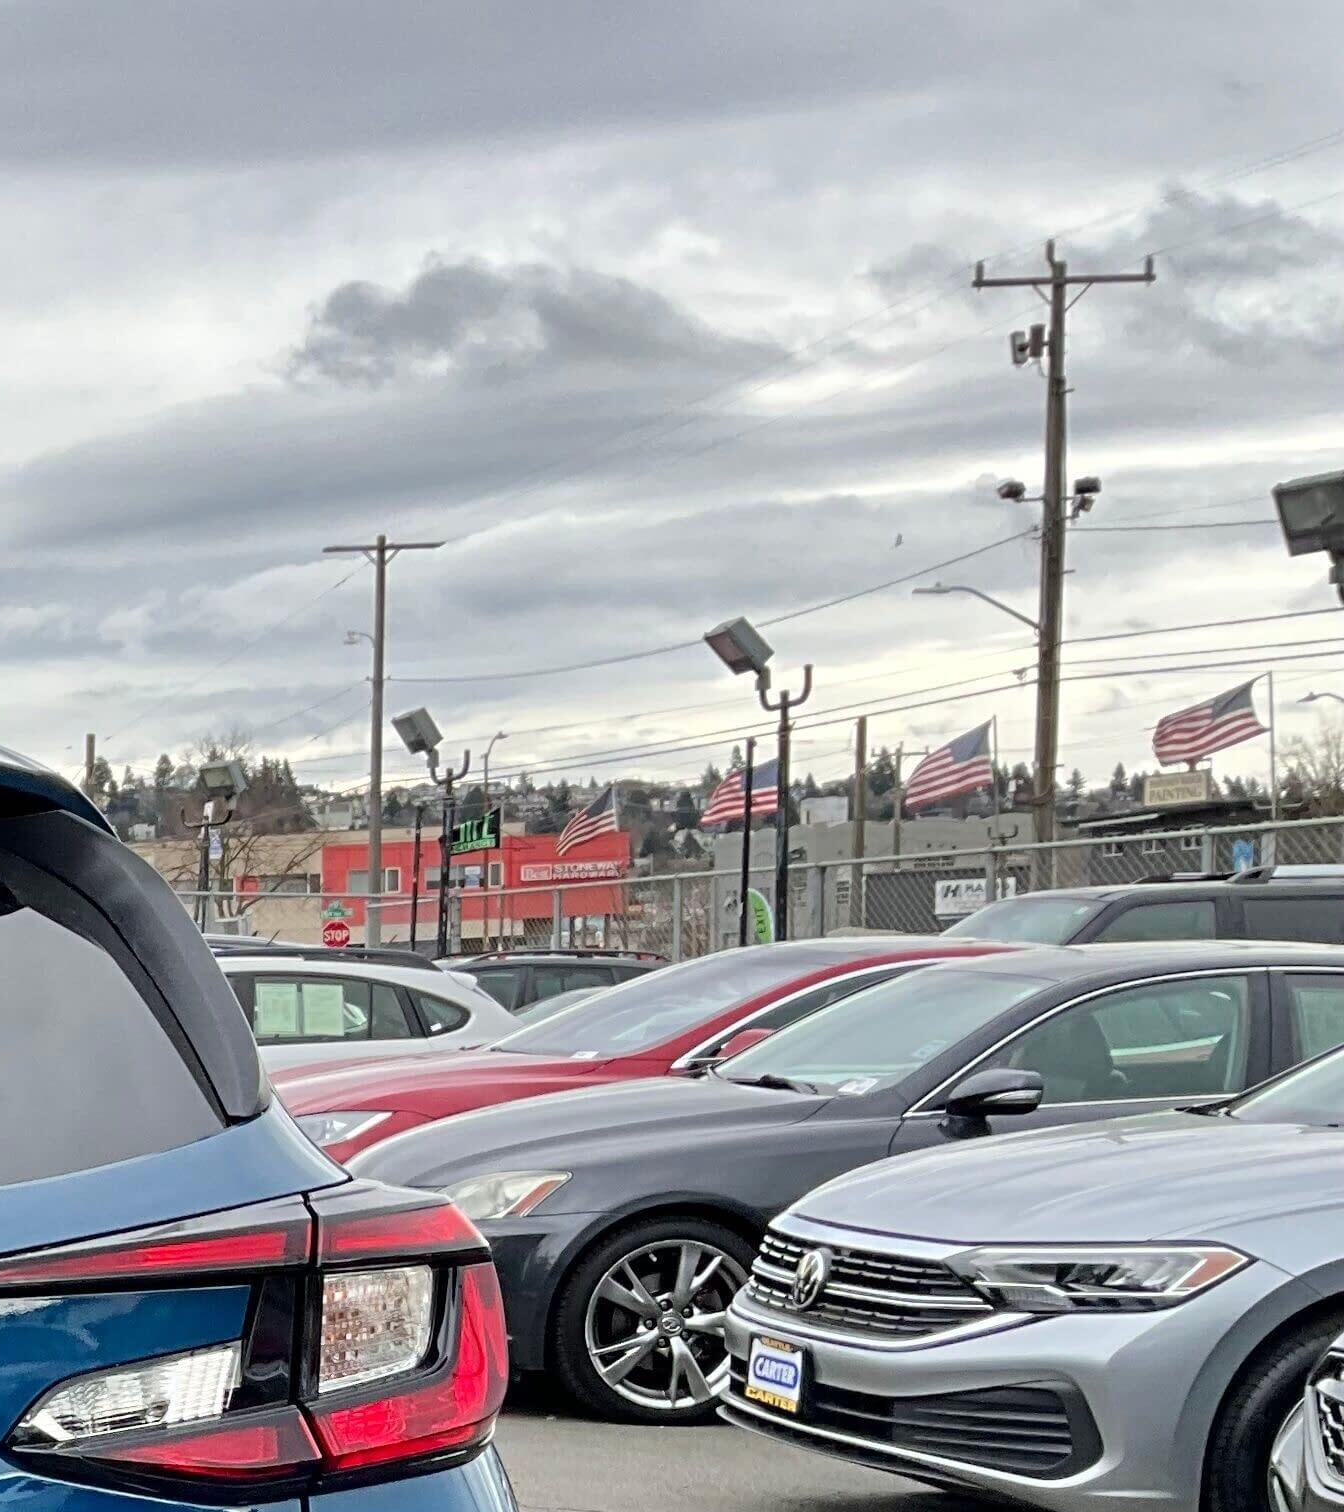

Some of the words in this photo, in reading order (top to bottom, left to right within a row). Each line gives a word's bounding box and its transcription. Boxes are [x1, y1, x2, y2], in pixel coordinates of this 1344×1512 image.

[754, 907, 767, 934] EXIT
[324, 930, 349, 941] STOP
[755, 1357, 796, 1386] CARTER
[745, 1386, 797, 1413] CARTER
